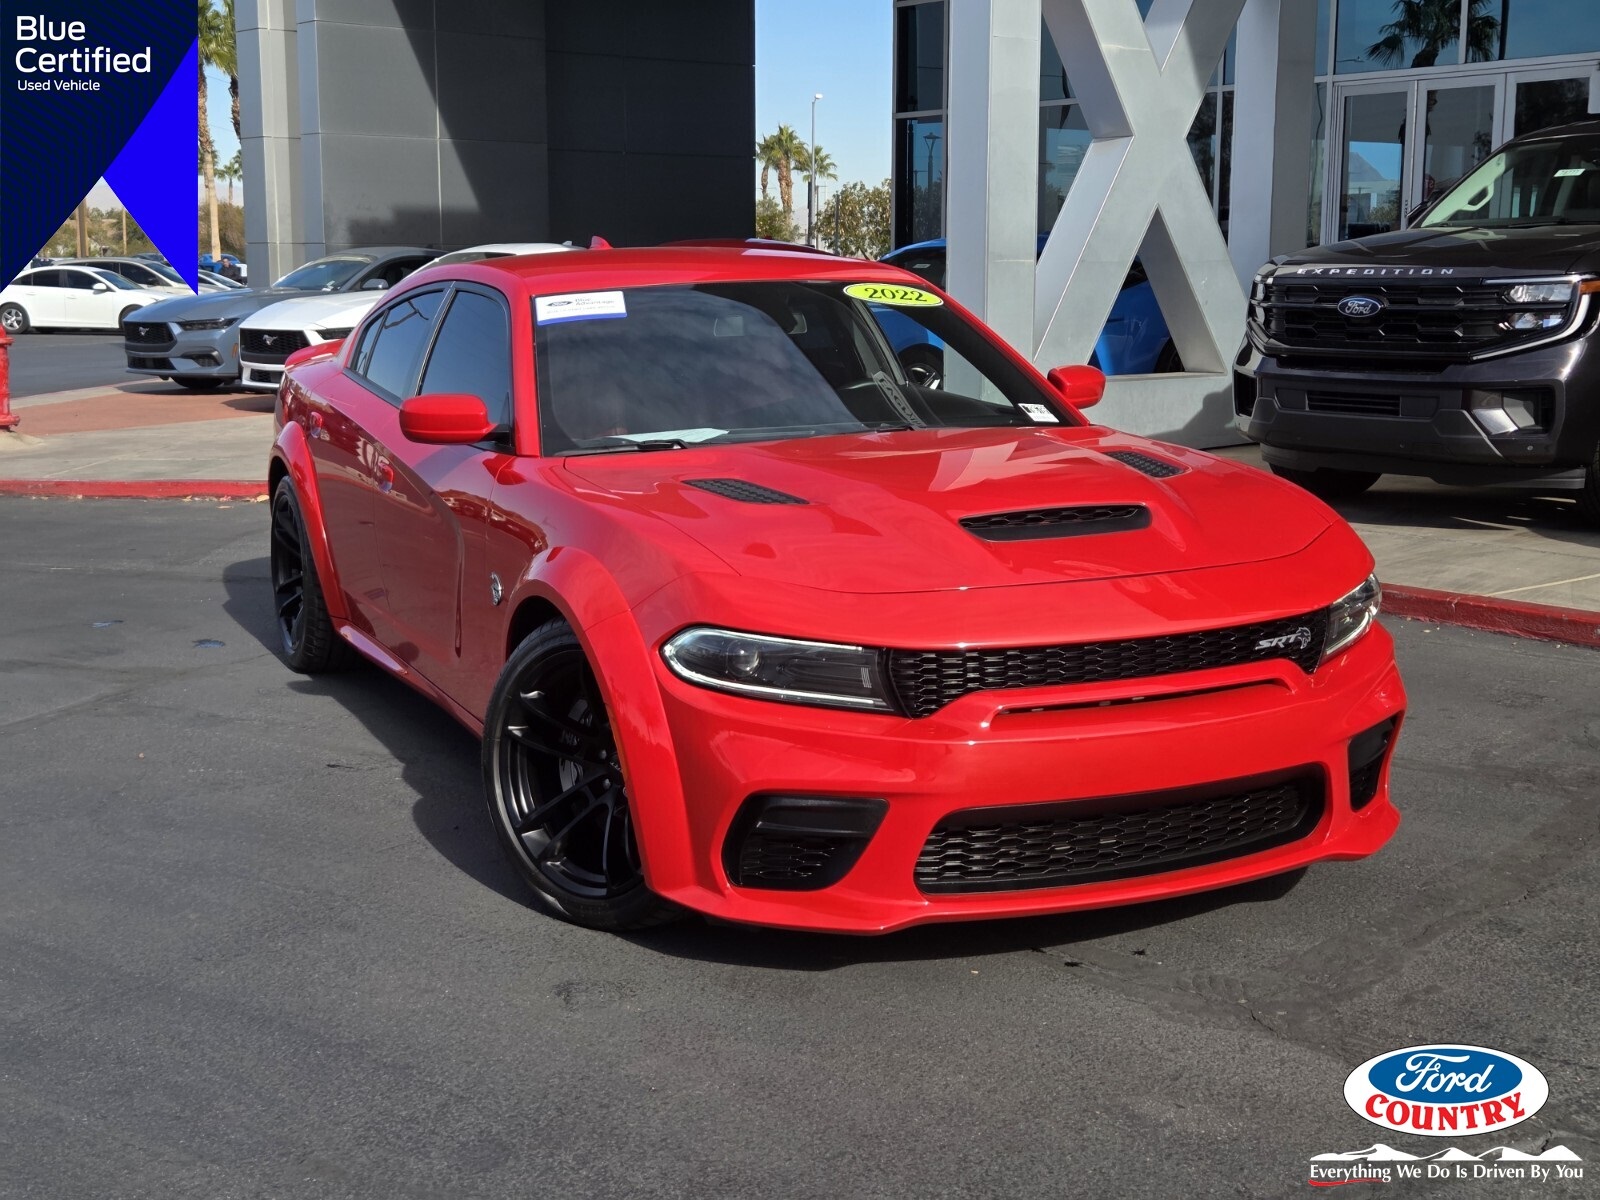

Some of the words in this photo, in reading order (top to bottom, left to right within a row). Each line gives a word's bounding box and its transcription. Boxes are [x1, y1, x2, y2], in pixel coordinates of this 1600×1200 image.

[1296, 267, 1455, 276] EXPEDITION
[864, 287, 928, 302] 2022
[1344, 300, 1372, 315] Ford
[1254, 632, 1301, 651] SRT
